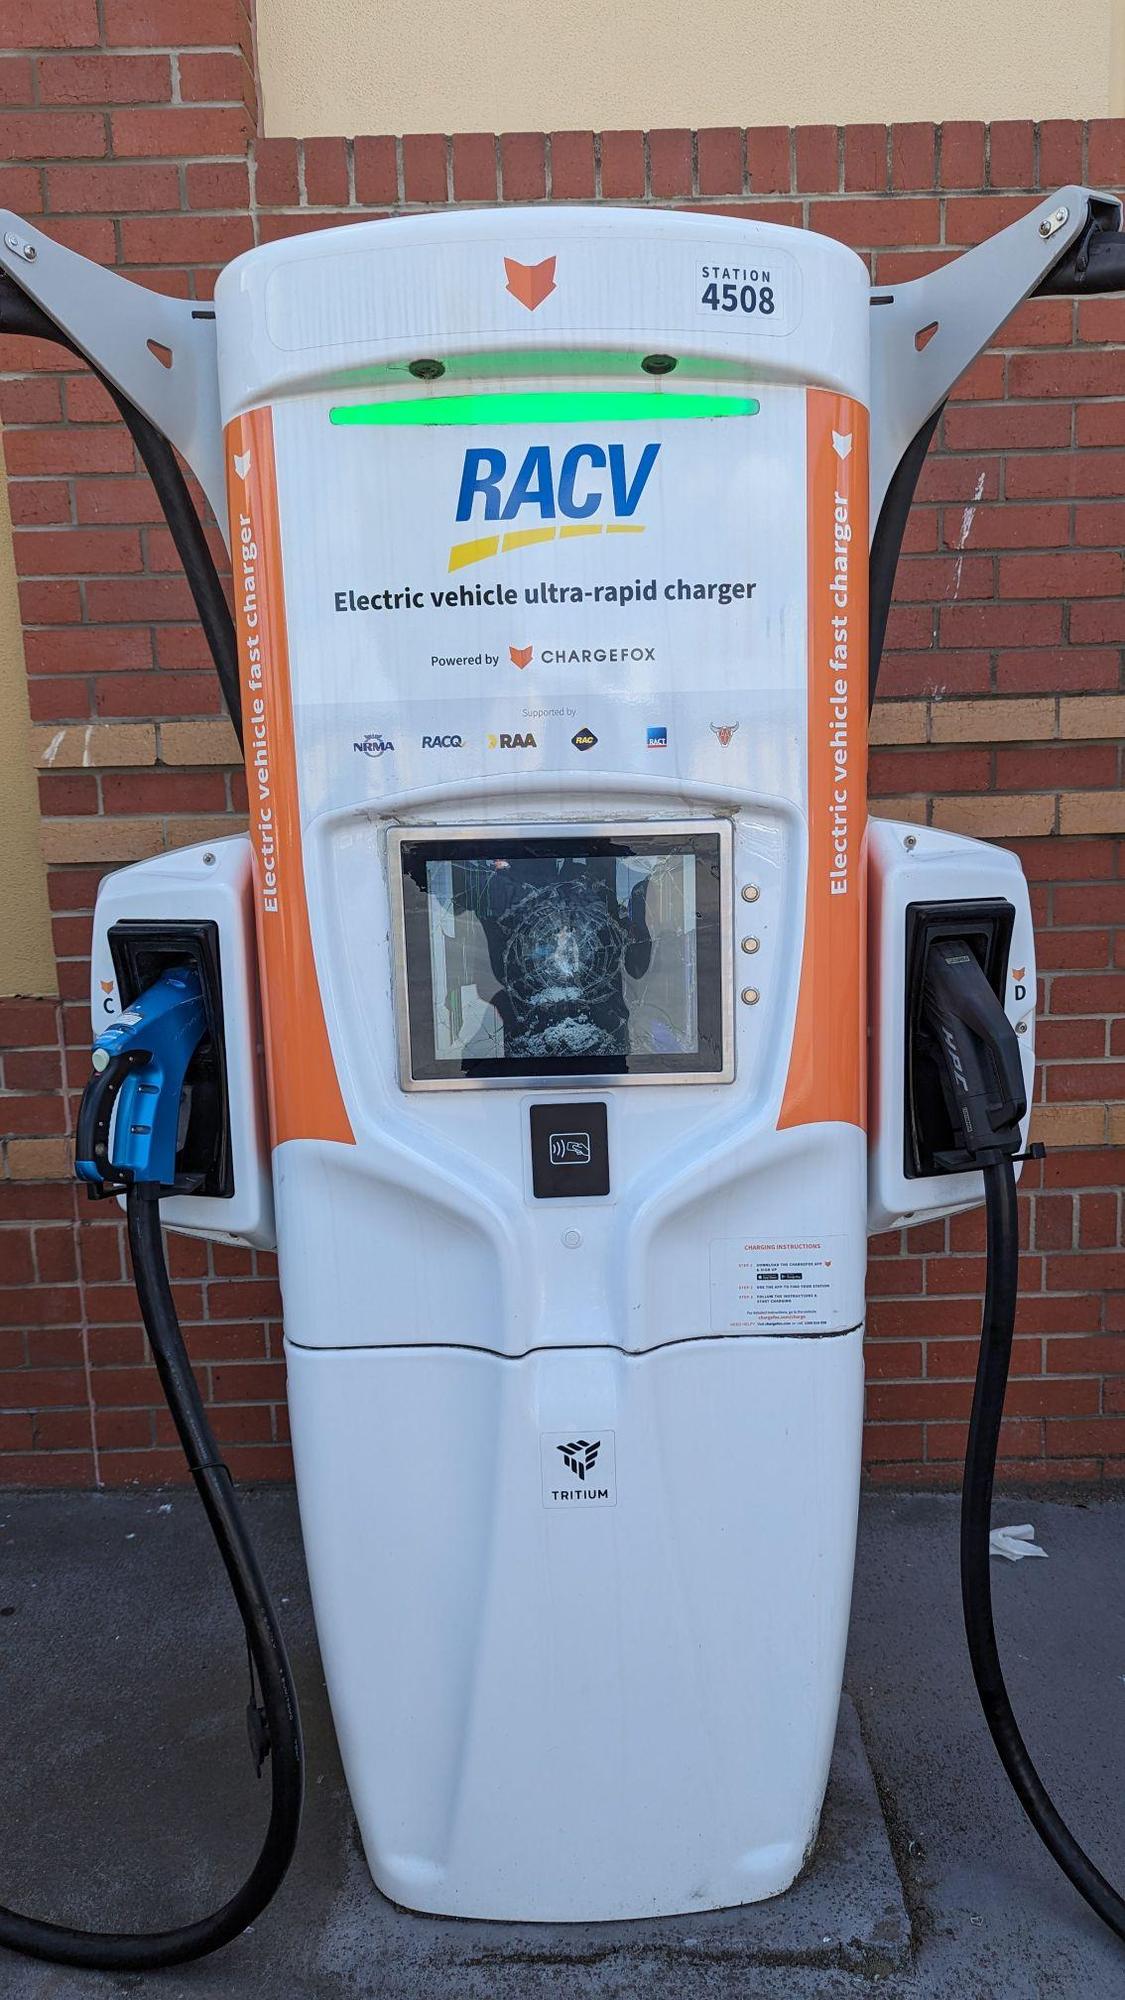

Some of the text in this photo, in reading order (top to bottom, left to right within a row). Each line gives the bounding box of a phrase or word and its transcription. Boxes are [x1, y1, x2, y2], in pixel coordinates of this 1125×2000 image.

[702, 266, 770, 282] STATION
[701, 283, 775, 315] 4508
[455, 443, 661, 522] RACV
[334, 579, 757, 612] Electric vehicle ultra-rapid charger
[431, 653, 499, 667] Powered by
[541, 648, 655, 664] CHARGEFOX
[828, 491, 852, 895] Electric vehicle fast charger
[240, 514, 279, 913] Electric vehicle fast charger
[522, 707, 578, 719] Supported by
[353, 741, 395, 752] NRMA
[422, 735, 463, 749] RACQ
[500, 733, 537, 749] RAA
[575, 736, 593, 744] RAC
[649, 738, 666, 746] RACT
[1015, 985, 1026, 1001] D
[103, 997, 115, 1014] C
[744, 1243, 776, 1251] CHARGING
[551, 1489, 609, 1501] TRITIUM
